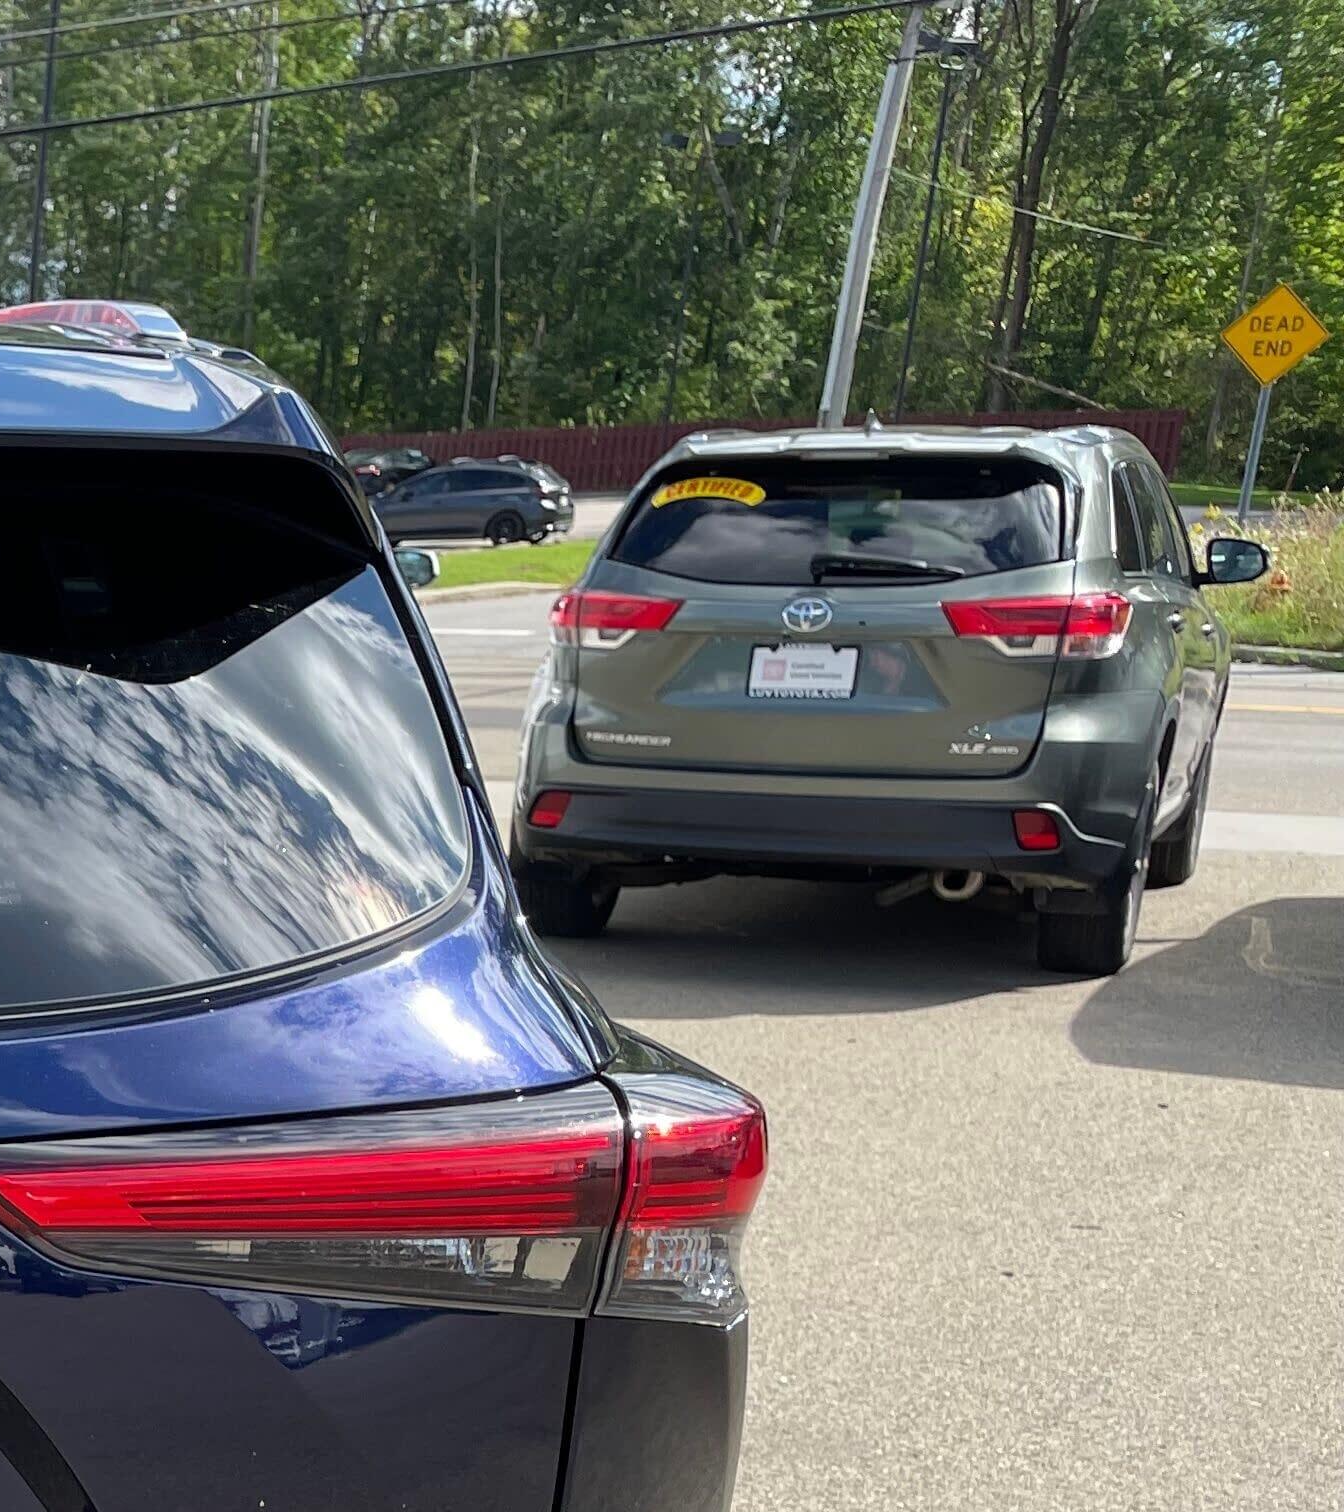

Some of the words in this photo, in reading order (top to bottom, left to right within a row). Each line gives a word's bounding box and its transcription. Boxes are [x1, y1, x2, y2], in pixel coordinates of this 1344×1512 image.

[1249, 316, 1305, 333] DEAD
[1253, 340, 1293, 357] END
[666, 480, 756, 499] CERTIFIED
[949, 743, 986, 755] XLE
